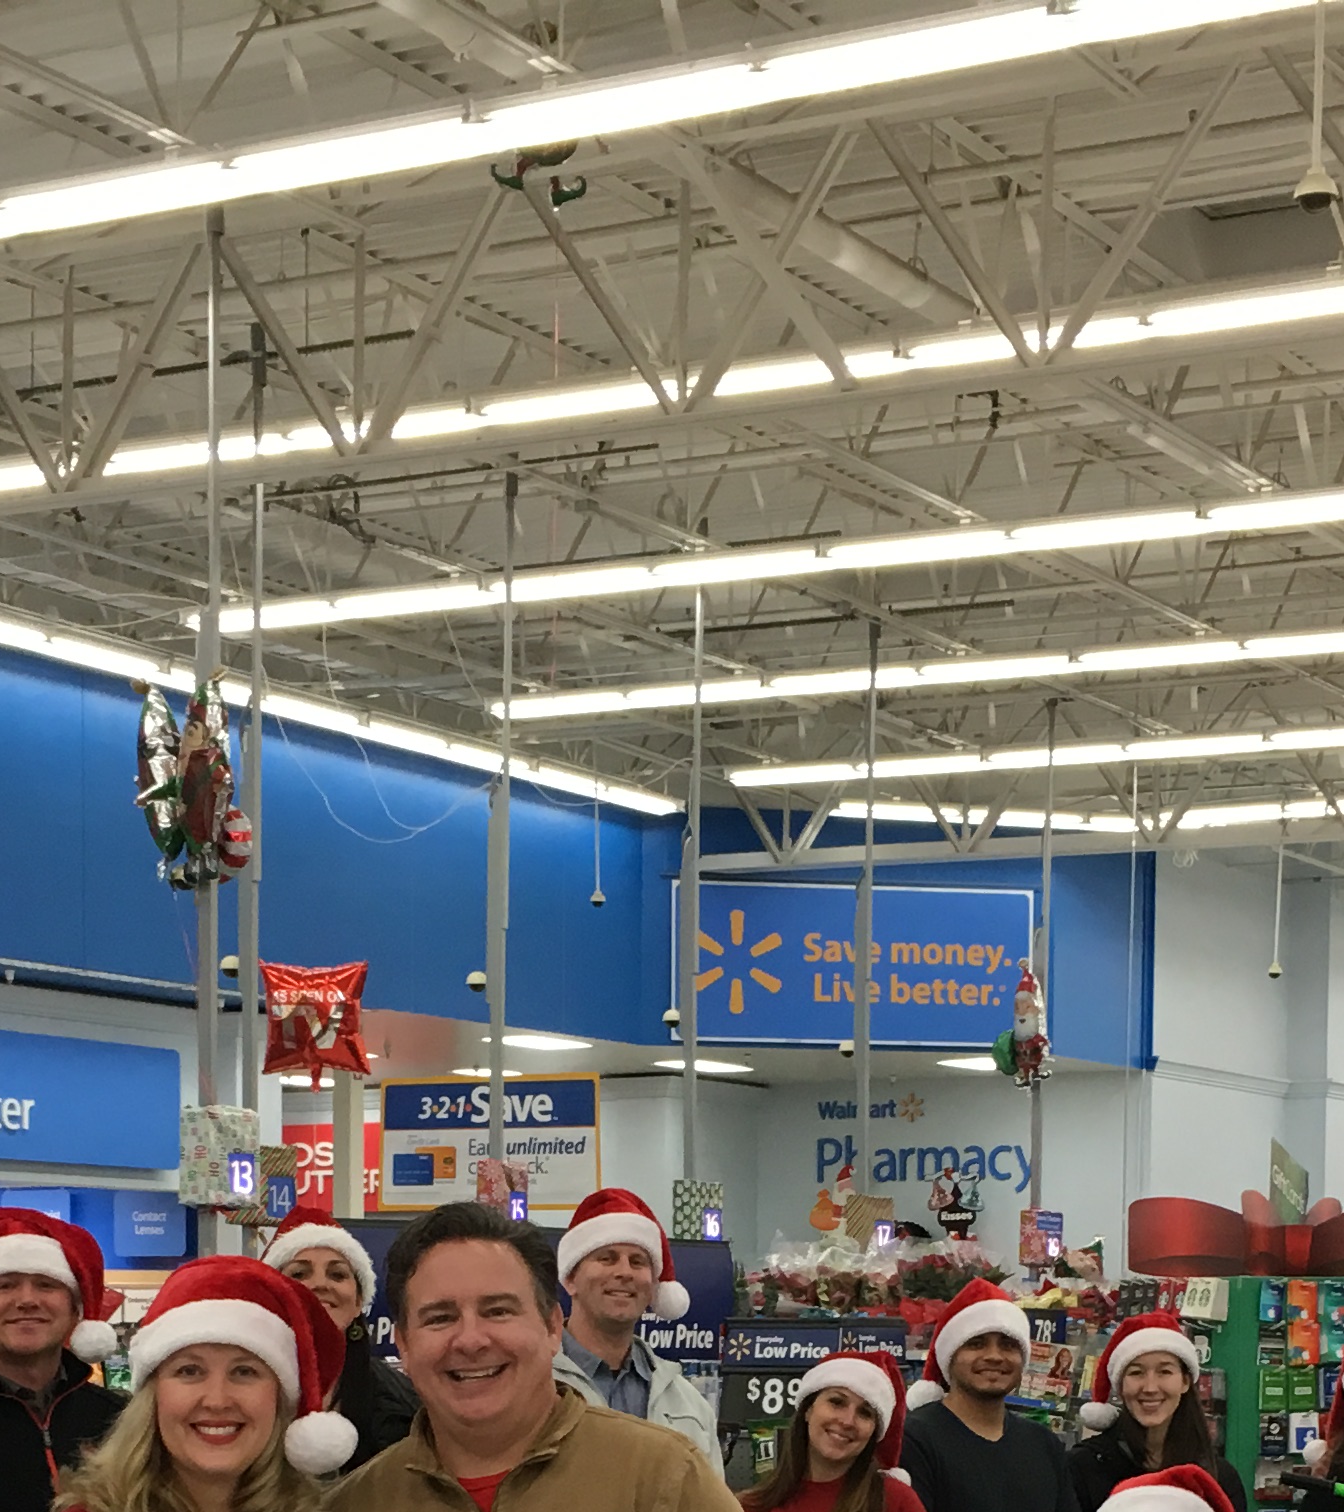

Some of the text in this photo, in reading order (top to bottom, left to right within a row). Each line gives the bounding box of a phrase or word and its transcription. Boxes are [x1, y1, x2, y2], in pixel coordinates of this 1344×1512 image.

[803, 932, 1012, 974] Save money.
[889, 973, 1001, 1006] better.
[505, 1135, 587, 1155] unlimited
[230, 1159, 254, 1195] 13
[268, 1183, 292, 1213] 14
[511, 1198, 525, 1221] 15
[705, 1213, 720, 1238] 16
[876, 1225, 891, 1247] 17
[640, 1322, 714, 1349] Low Price
[754, 1343, 831, 1359] Low Price
